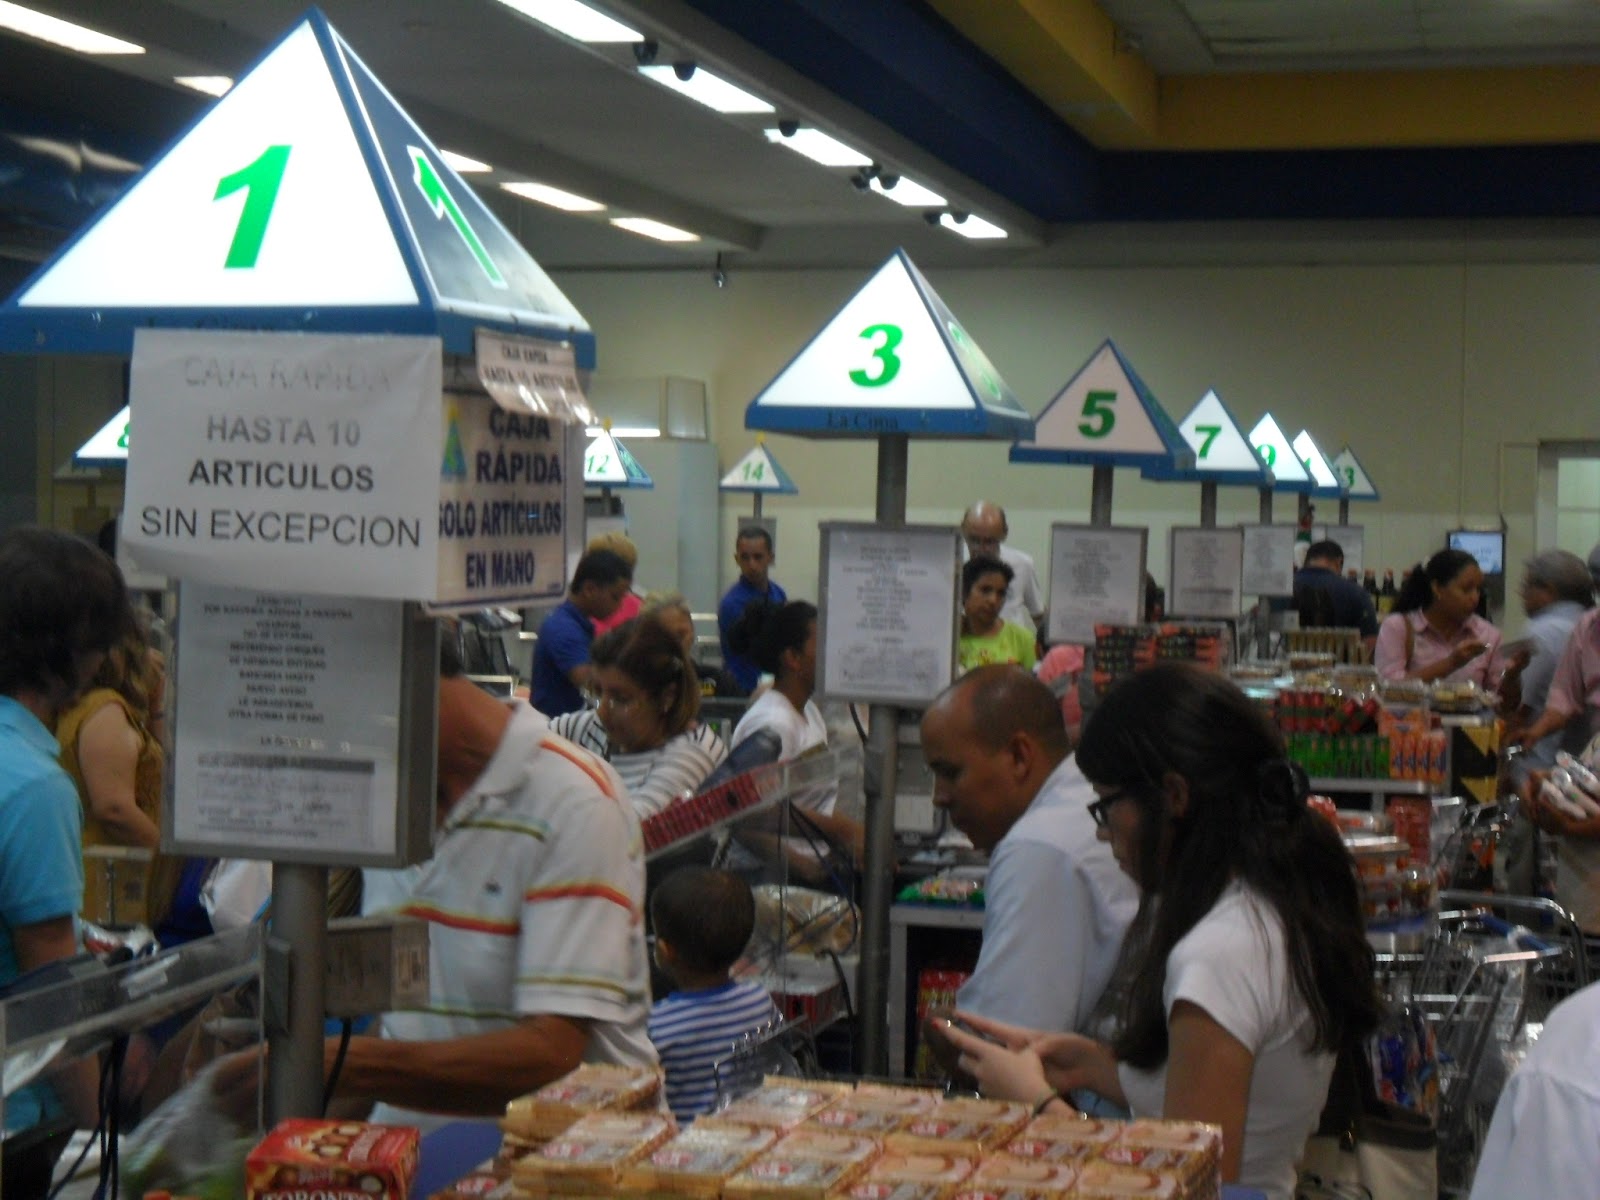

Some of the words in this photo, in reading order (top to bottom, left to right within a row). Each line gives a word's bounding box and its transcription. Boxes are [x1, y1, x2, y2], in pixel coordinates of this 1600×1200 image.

[213, 145, 292, 268] 1
[185, 357, 257, 388] CAJA
[849, 324, 903, 388] 3
[207, 415, 315, 446] HASTA
[328, 420, 361, 447] 10
[489, 405, 551, 440] CAJA
[1078, 390, 1118, 439] 5
[1195, 424, 1223, 460] 7
[1256, 444, 1277, 469] 9
[188, 459, 375, 492] ARTICULOS
[587, 454, 609, 473] 12
[742, 463, 765, 482] 14
[140, 506, 197, 538] SIN
[210, 509, 421, 548] EXCEPCION
[466, 552, 487, 588] EN
[492, 551, 535, 585] MANO
